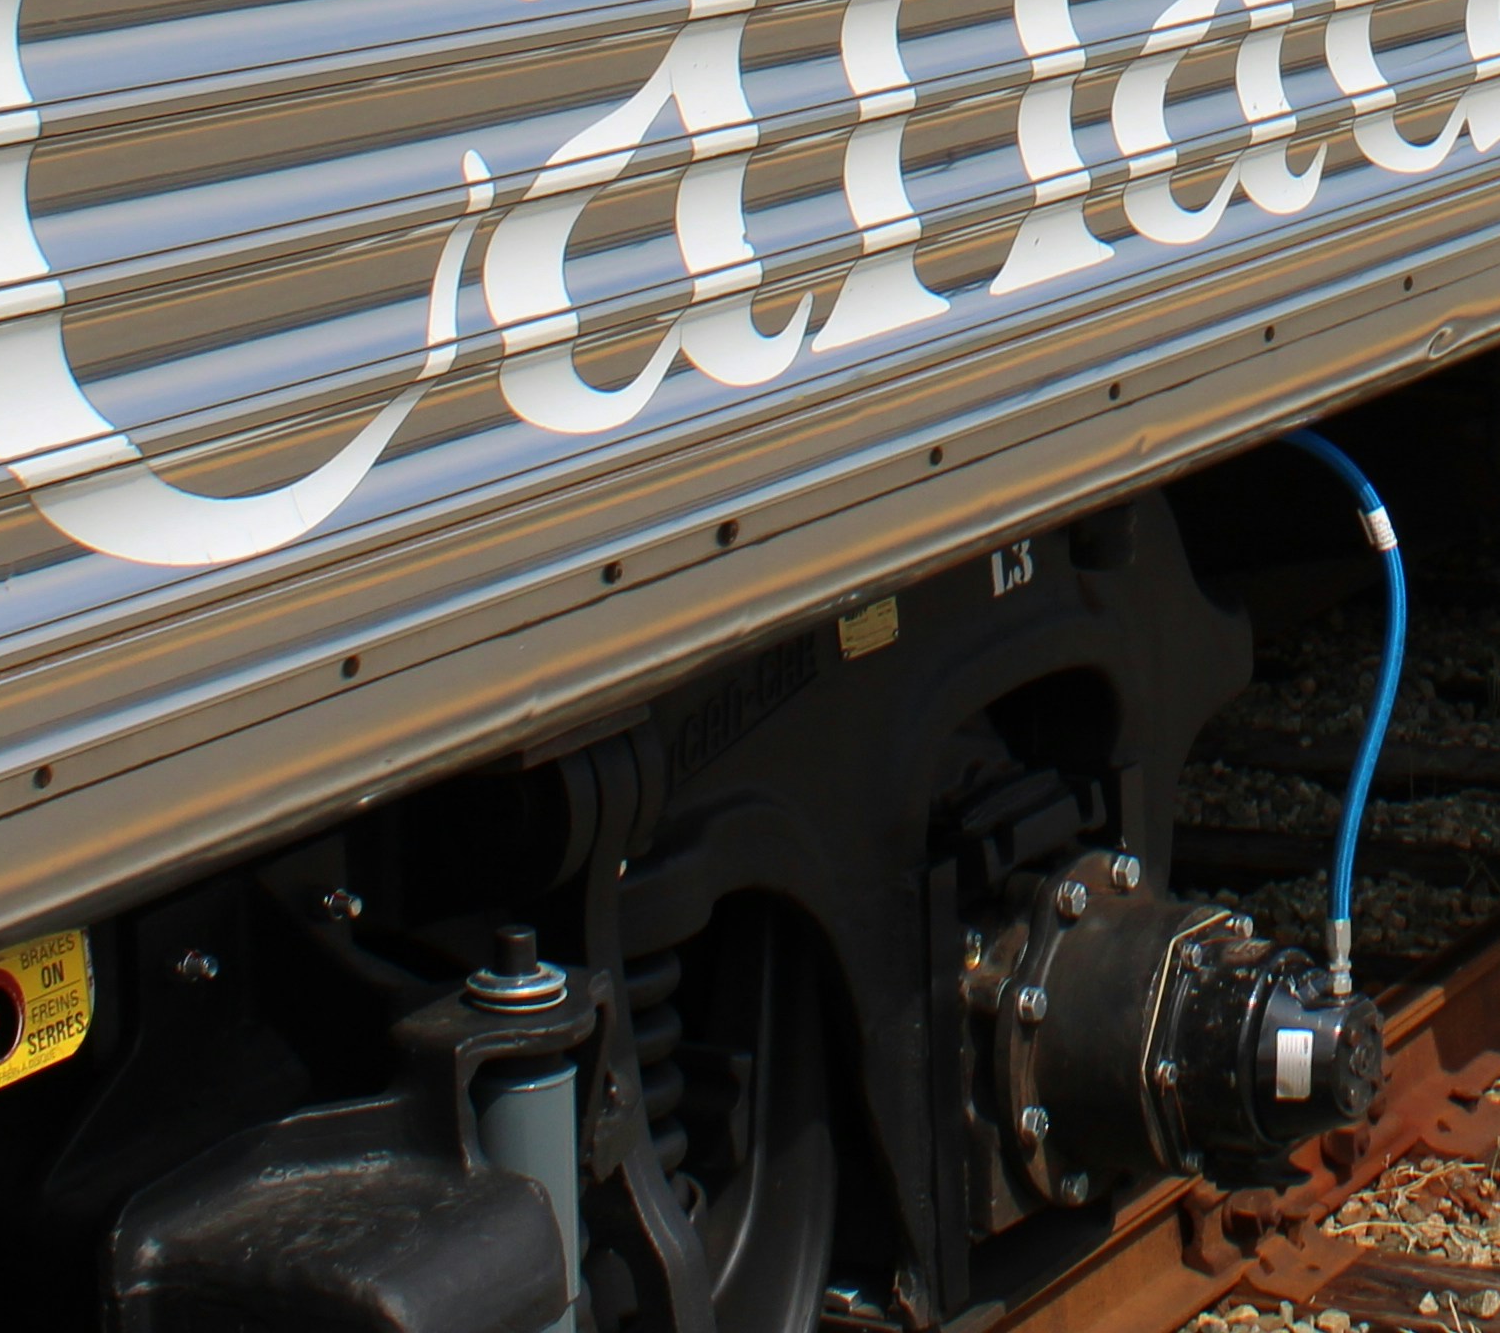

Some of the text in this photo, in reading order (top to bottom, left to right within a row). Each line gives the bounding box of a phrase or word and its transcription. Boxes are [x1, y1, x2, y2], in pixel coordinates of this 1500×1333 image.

[991, 539, 1033, 597] L3
[20, 935, 75, 970] BRAKES
[41, 961, 65, 989] ON
[31, 989, 80, 1024] FREINS
[27, 1010, 85, 1056] SERRÉS
